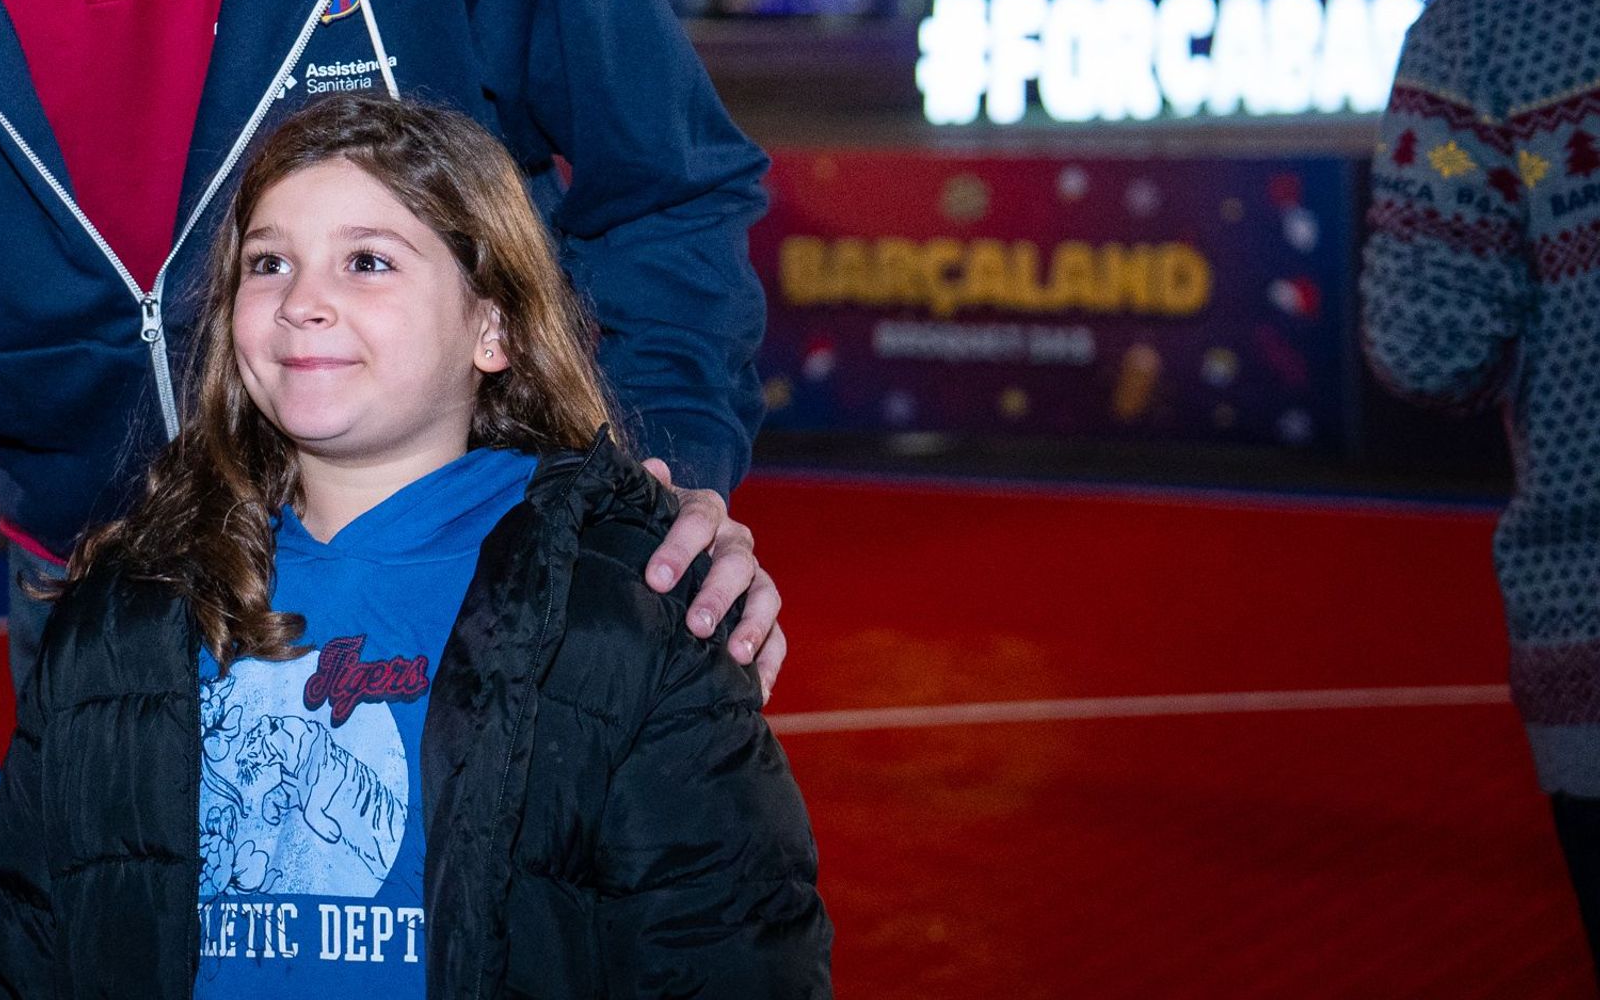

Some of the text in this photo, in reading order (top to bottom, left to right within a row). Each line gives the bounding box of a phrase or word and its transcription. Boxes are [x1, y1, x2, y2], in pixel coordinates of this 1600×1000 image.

[305, 55, 398, 78] Assistèna
[306, 75, 372, 94] Sanitària
[1550, 182, 1600, 217] BAR
[780, 235, 1212, 318] BARÇALAND
[303, 633, 430, 729] Tigers
[197, 903, 425, 963] LETIC DEPT
